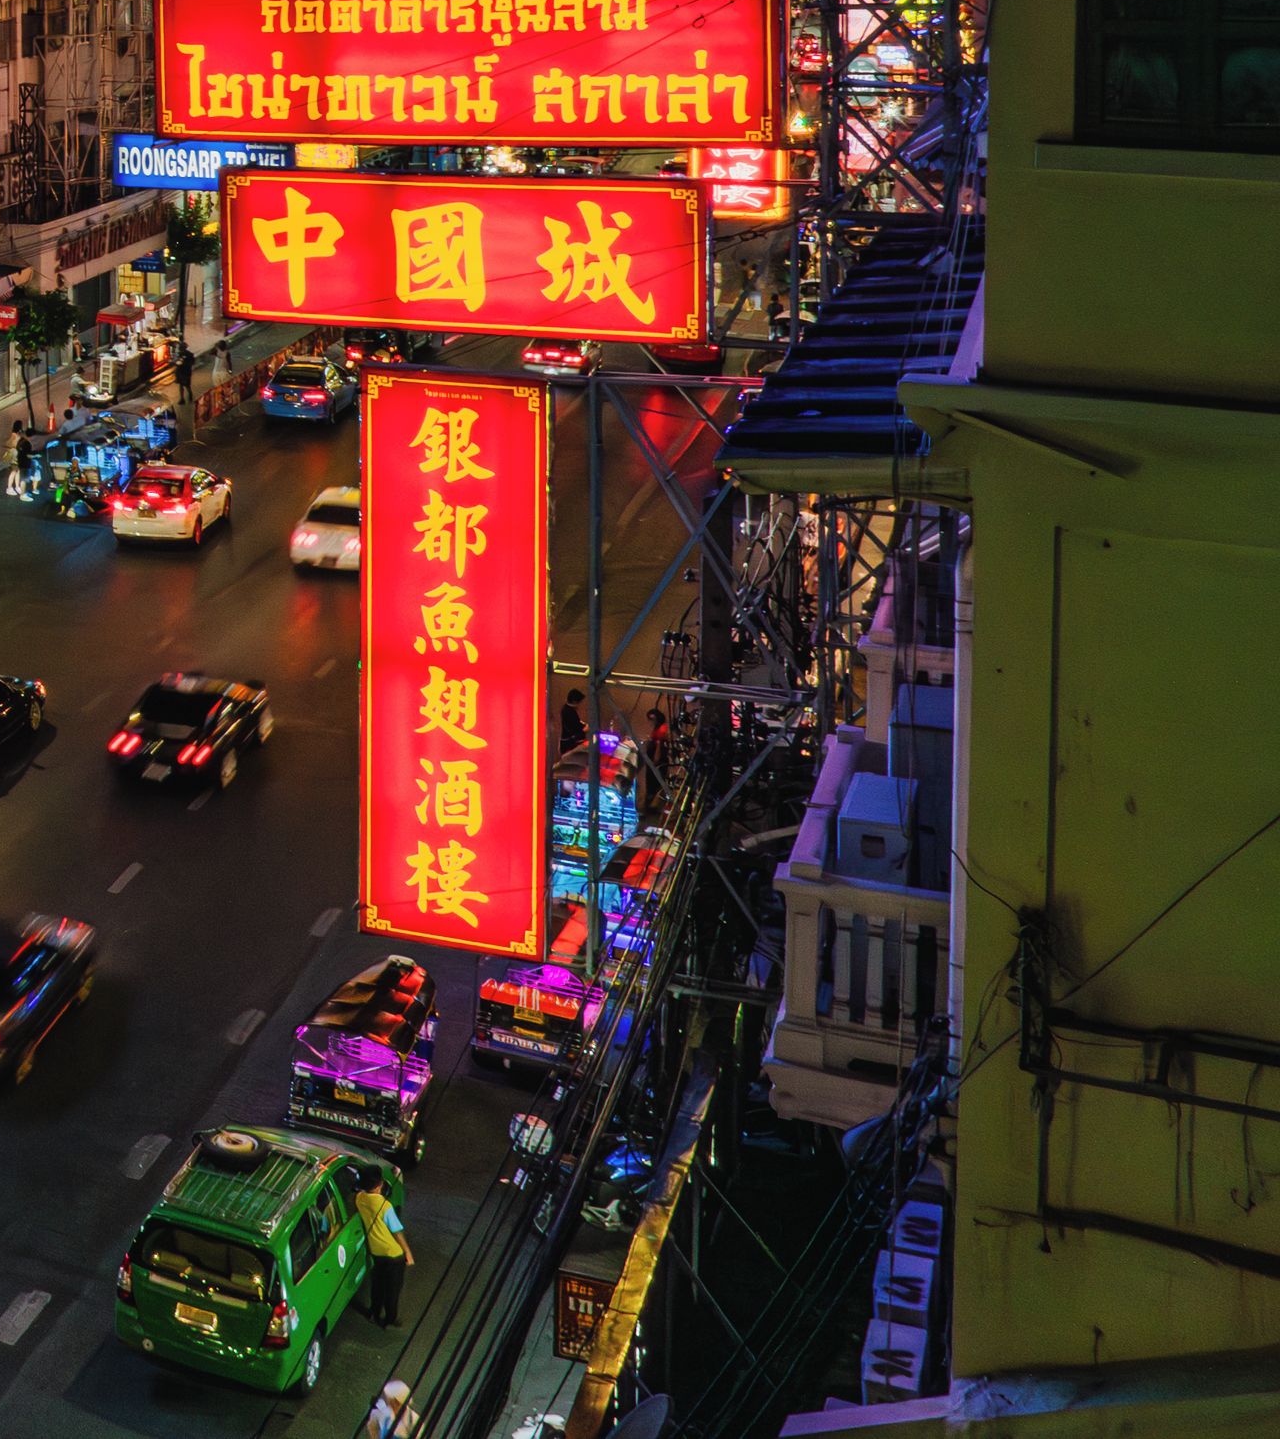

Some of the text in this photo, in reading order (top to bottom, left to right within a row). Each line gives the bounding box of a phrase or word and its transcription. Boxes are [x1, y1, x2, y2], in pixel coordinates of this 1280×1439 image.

[176, 42, 752, 124] ไชน่าทาวน์ สกาล่า
[118, 146, 218, 179] ROONGSARP
[252, 187, 656, 325] 中國城
[405, 406, 495, 928] 銀都魚翅酒樓
